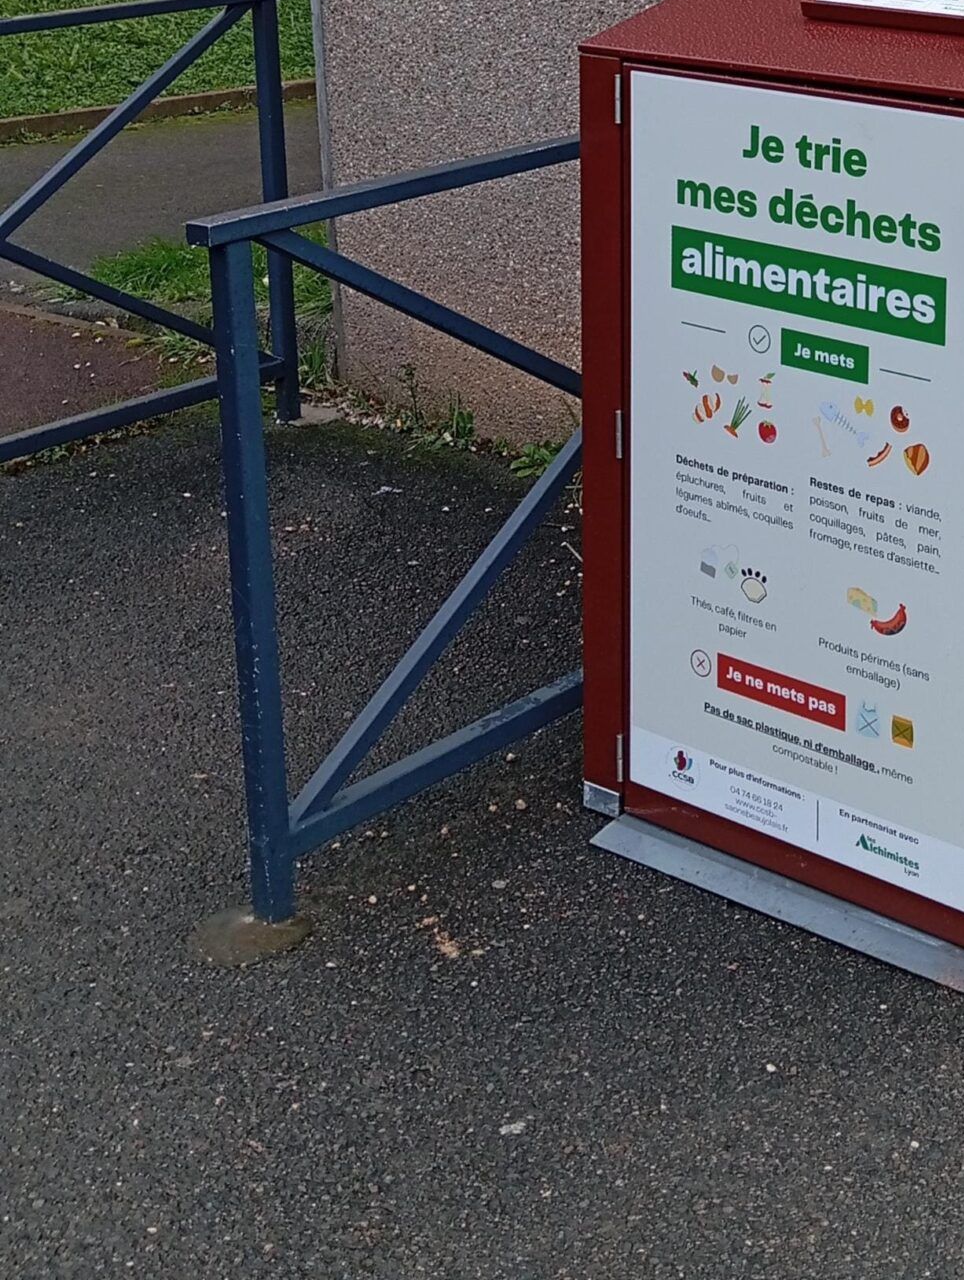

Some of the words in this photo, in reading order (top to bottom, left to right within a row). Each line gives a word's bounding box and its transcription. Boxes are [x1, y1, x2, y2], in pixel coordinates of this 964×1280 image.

[743, 125, 784, 163] Je
[796, 134, 867, 177] trie
[676, 178, 757, 217] mes
[769, 188, 941, 252] déchets
[681, 242, 936, 324] alimentaires
[794, 343, 811, 359] Je
[814, 350, 855, 369] mets
[676, 454, 714, 473] Déchets
[717, 466, 729, 478] de
[732, 471, 788, 494] préparation
[676, 471, 726, 494] épluchures,
[742, 489, 767, 505] fruits
[784, 503, 793, 512] et
[676, 487, 713, 507] légumes
[753, 511, 794, 530] coquilles
[809, 477, 844, 495] Restes
[848, 488, 861, 499] de
[865, 493, 895, 508] repas
[906, 504, 942, 522] viande,
[809, 496, 849, 515] poisson,
[859, 507, 885, 523] fruits
[895, 518, 908, 530] de
[918, 525, 941, 540] mer,
[809, 513, 866, 537] coquillages,
[876, 531, 906, 549] pâtes,
[917, 543, 941, 558] pain,
[809, 528, 852, 551] fromage,
[854, 542, 884, 559] restes
[715, 605, 736, 620] café,
[738, 611, 763, 628] filtres
[765, 621, 777, 632] en
[719, 623, 747, 639] papier
[818, 637, 859, 658] Produits
[860, 652, 900, 672] périmés
[902, 663, 930, 681] (sans
[846, 665, 900, 690] emballage)
[726, 666, 742, 682] Je
[745, 674, 763, 690] ne
[767, 682, 805, 704] mets
[808, 695, 836, 715] pas
[704, 702, 720, 716] Pas
[722, 709, 734, 721] de
[736, 715, 753, 728] sac
[803, 739, 812, 749] ni
[881, 767, 914, 784] même
[772, 744, 833, 773] compostable
[709, 759, 727, 771] Pour
[728, 767, 745, 778] plus
[839, 808, 850, 819] En
[851, 814, 897, 836] partenariat
[899, 832, 919, 845] avec
[904, 867, 919, 878] Lyon
